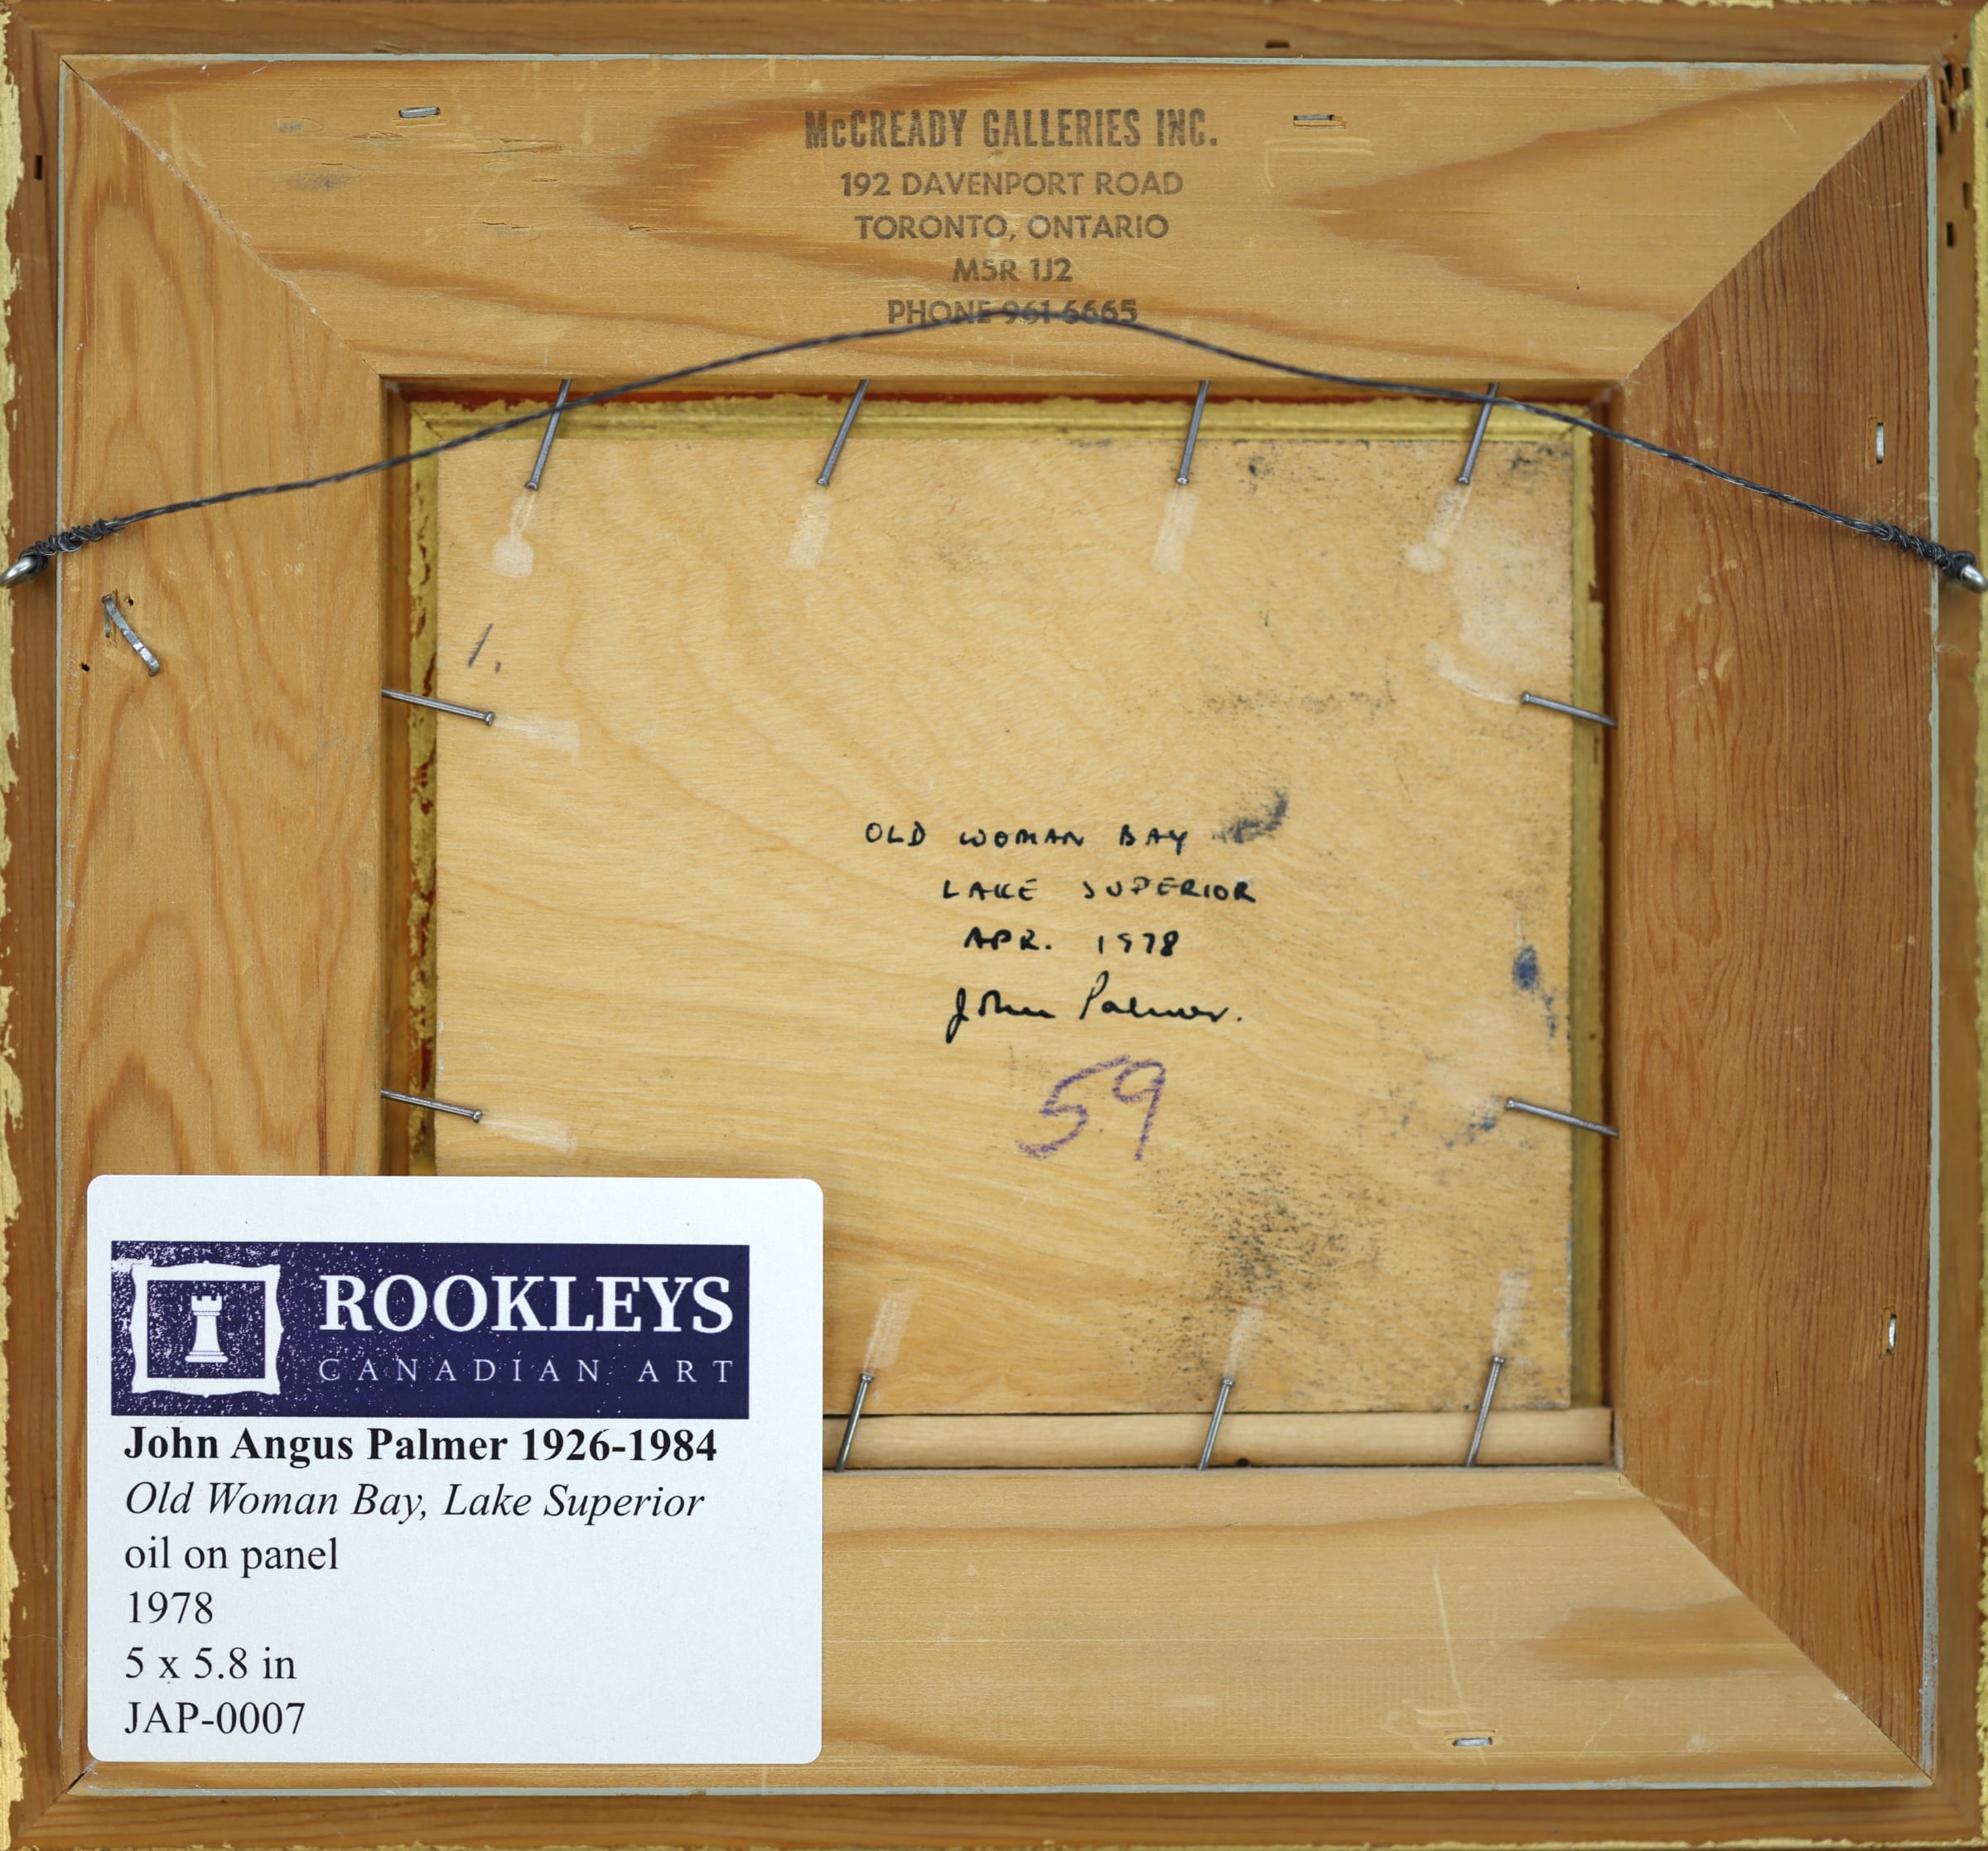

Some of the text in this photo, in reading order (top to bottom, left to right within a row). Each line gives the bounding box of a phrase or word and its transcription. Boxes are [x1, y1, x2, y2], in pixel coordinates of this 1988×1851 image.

[805, 108, 1218, 149] McCREADY GALLERIES INC.
[841, 171, 1183, 196] 192 DAVENPORT ROAD
[855, 215, 1169, 242] TORONTO, ONTARIO
[953, 258, 1073, 282] M5R 1J2
[888, 299, 1138, 325] PHONE 9616665
[866, 821, 926, 846] OLD
[1120, 824, 1189, 855] BAY
[943, 876, 1256, 903] LAKE SUPERIOR
[964, 927, 1180, 957] APR. 1978
[946, 988, 1055, 1044] John
[1015, 1054, 1166, 1161] 59
[319, 1274, 734, 1334] ROOKLEYS
[319, 1357, 733, 1383] CANADIAN ART
[124, 1426, 717, 1469] John Angus Palmer 1926-1984
[126, 1482, 706, 1526] Old Woman Bay, Lake Superior
[124, 1538, 339, 1579] oil on panel
[128, 1591, 214, 1624] 1978
[126, 1646, 297, 1680] 5 x 5.8 in
[124, 1701, 306, 1737] JAP-0007
